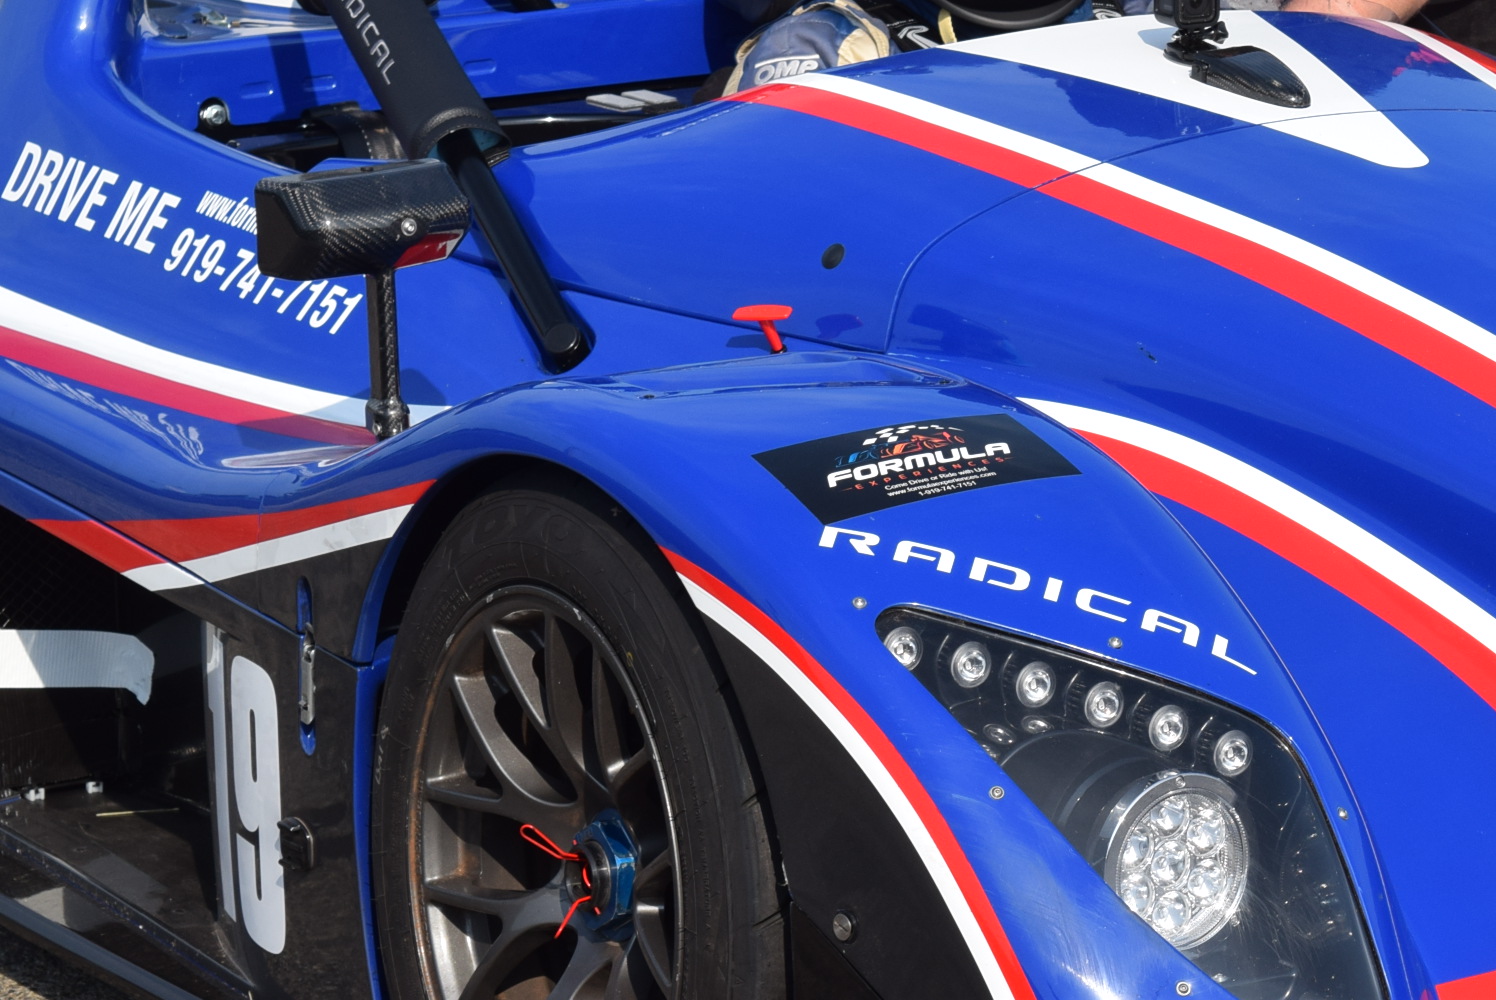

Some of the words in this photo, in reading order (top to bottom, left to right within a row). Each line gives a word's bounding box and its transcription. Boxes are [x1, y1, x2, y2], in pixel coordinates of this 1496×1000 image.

[754, 58, 819, 86] OMP
[1, 141, 119, 232] DRIVE
[104, 180, 181, 254] ME
[827, 442, 1011, 488] FORMULA
[855, 457, 1005, 490] EXPERIENCES
[884, 481, 908, 490] Come
[908, 477, 930, 486] Drive
[938, 471, 957, 479] Ride
[887, 471, 997, 497] www.formulaexperiences.com
[918, 480, 977, 496] 1-919-741-7151
[818, 525, 1258, 675] RADICAL
[207, 634, 287, 955] 19
